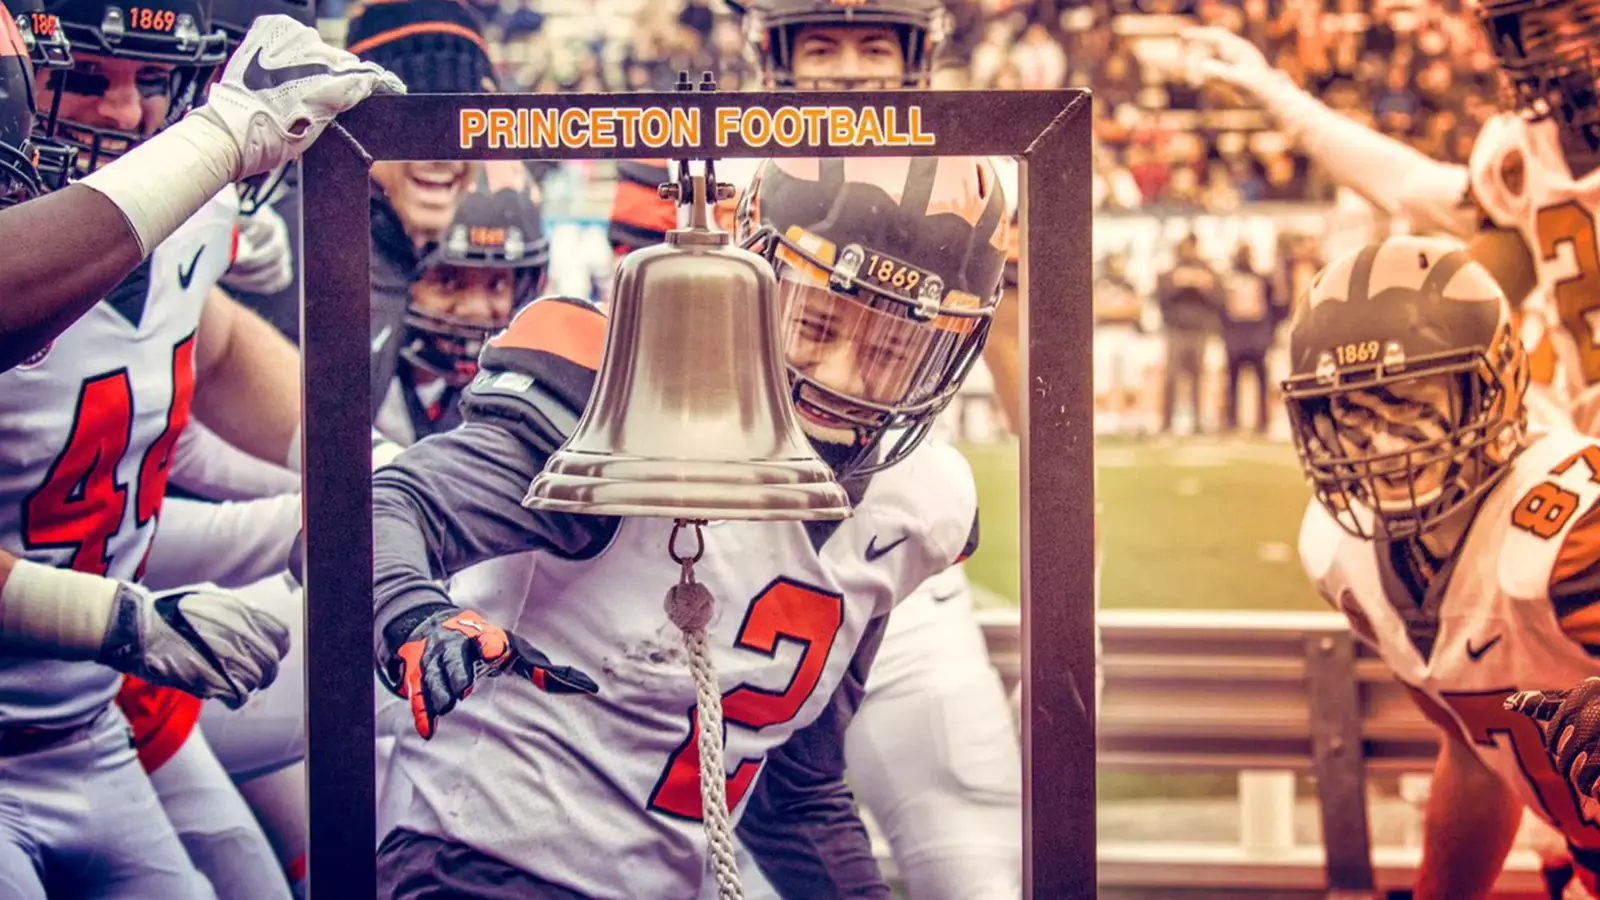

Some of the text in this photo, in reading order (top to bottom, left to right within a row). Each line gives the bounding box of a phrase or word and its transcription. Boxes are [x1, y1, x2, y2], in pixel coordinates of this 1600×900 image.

[130, 7, 176, 32] 1869
[460, 106, 936, 149] PRINCETON FOOTBALL
[867, 254, 921, 291] 1869
[1335, 339, 1380, 365] 1869
[645, 574, 845, 824] 2
